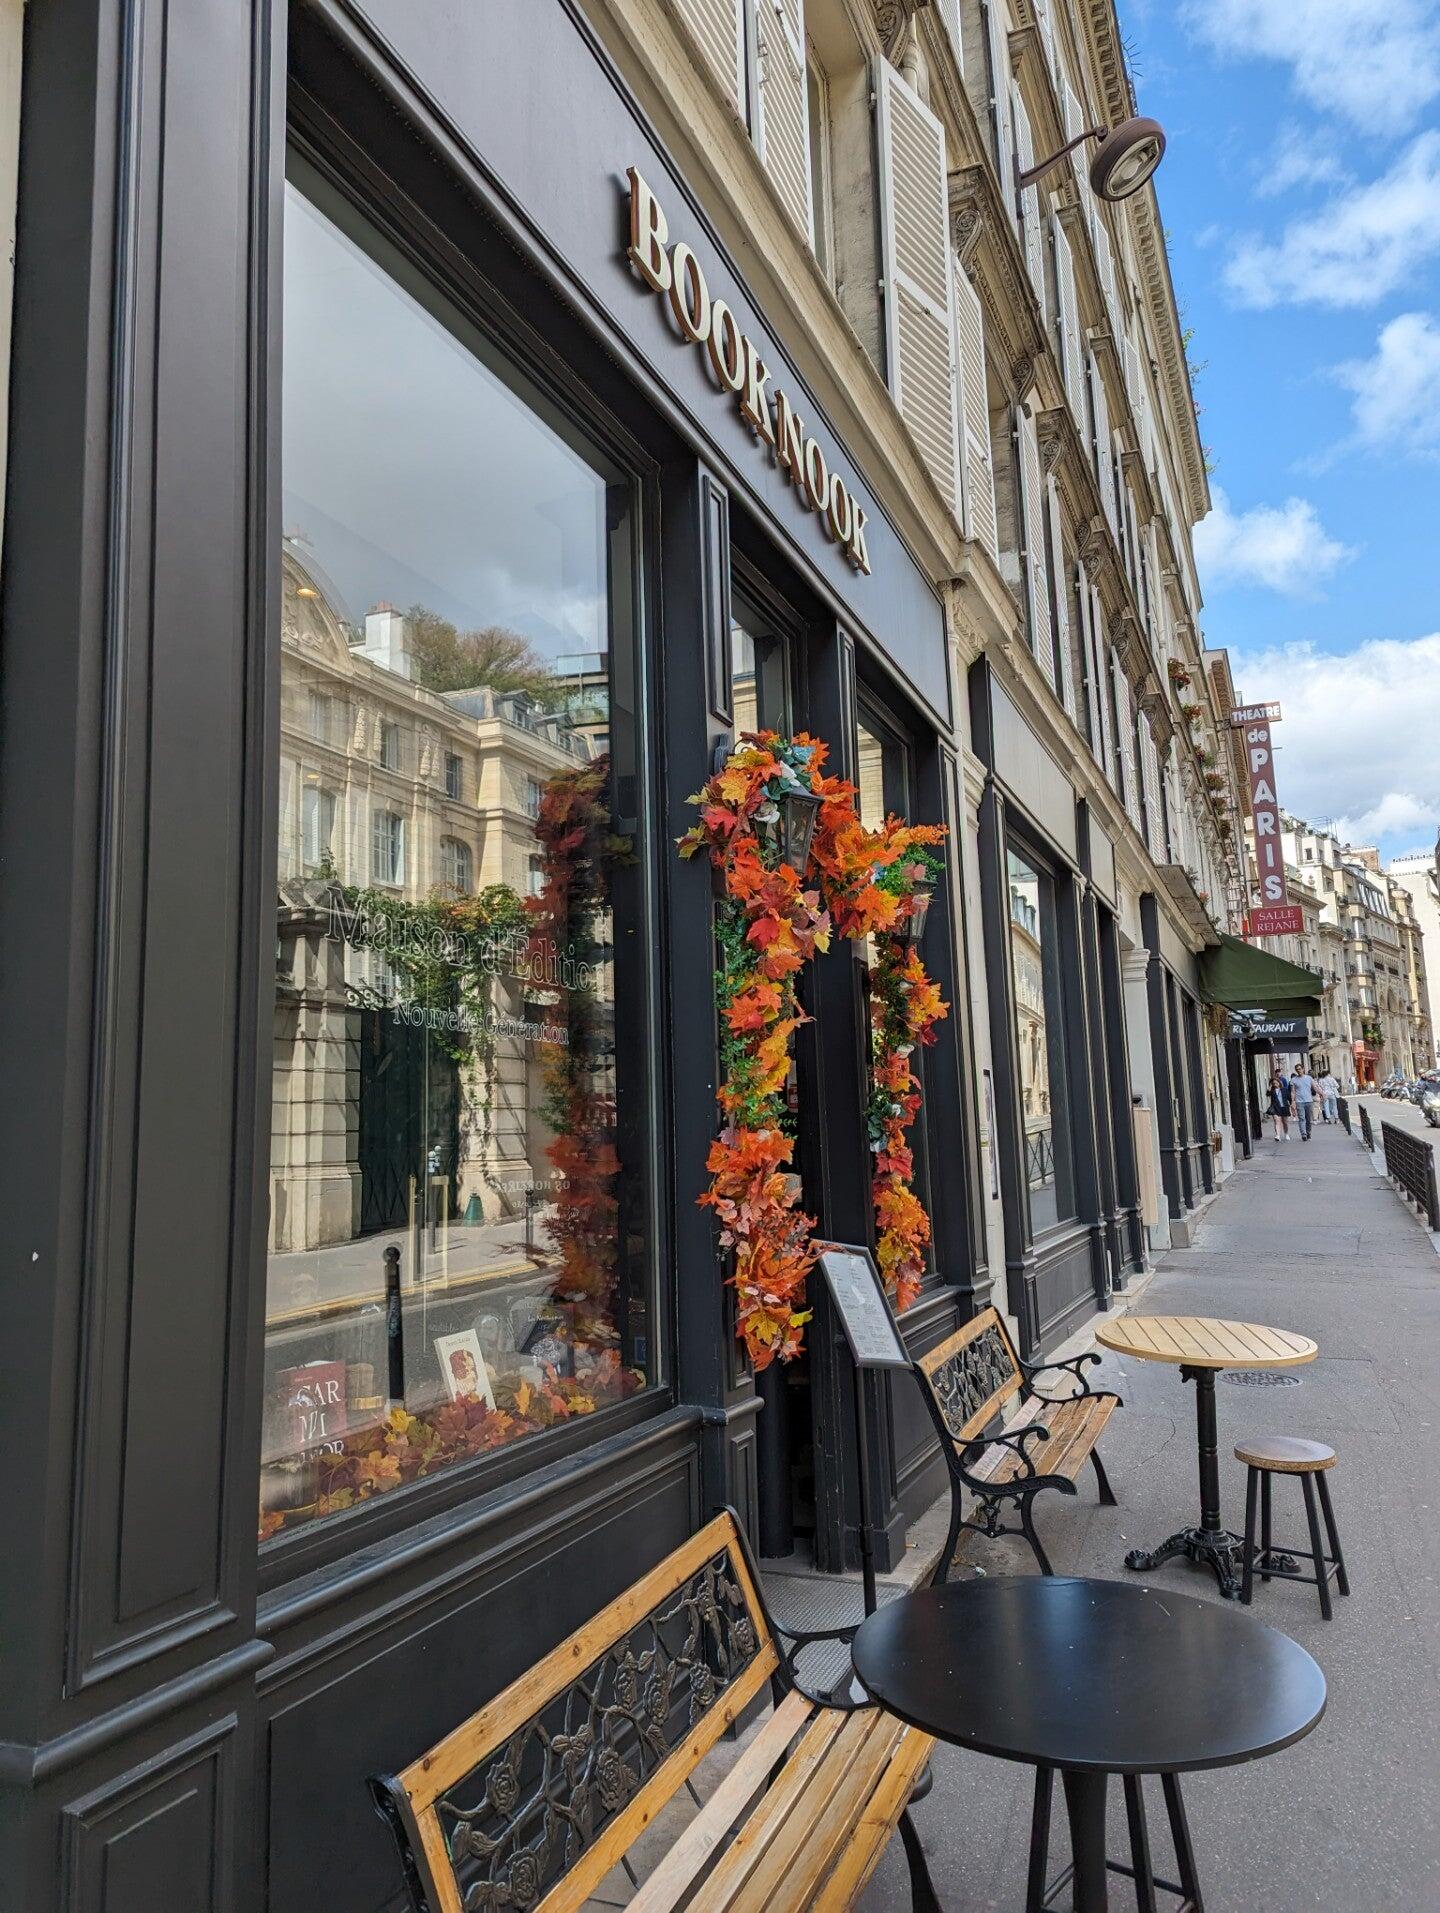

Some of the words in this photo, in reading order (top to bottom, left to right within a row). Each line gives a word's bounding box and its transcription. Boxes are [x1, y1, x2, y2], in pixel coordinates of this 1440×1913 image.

[626, 166, 775, 447] BOOK
[775, 389, 871, 576] NOOK
[1232, 705, 1280, 722] THEATRE
[1247, 728, 1268, 744] de
[1250, 747, 1282, 900] PARIS
[324, 886, 473, 968] Maison
[1257, 920, 1299, 932] REJANE
[1258, 909, 1295, 921] SALLE
[393, 1000, 482, 1033] Nouvelle
[482, 1008, 570, 1045] Génération
